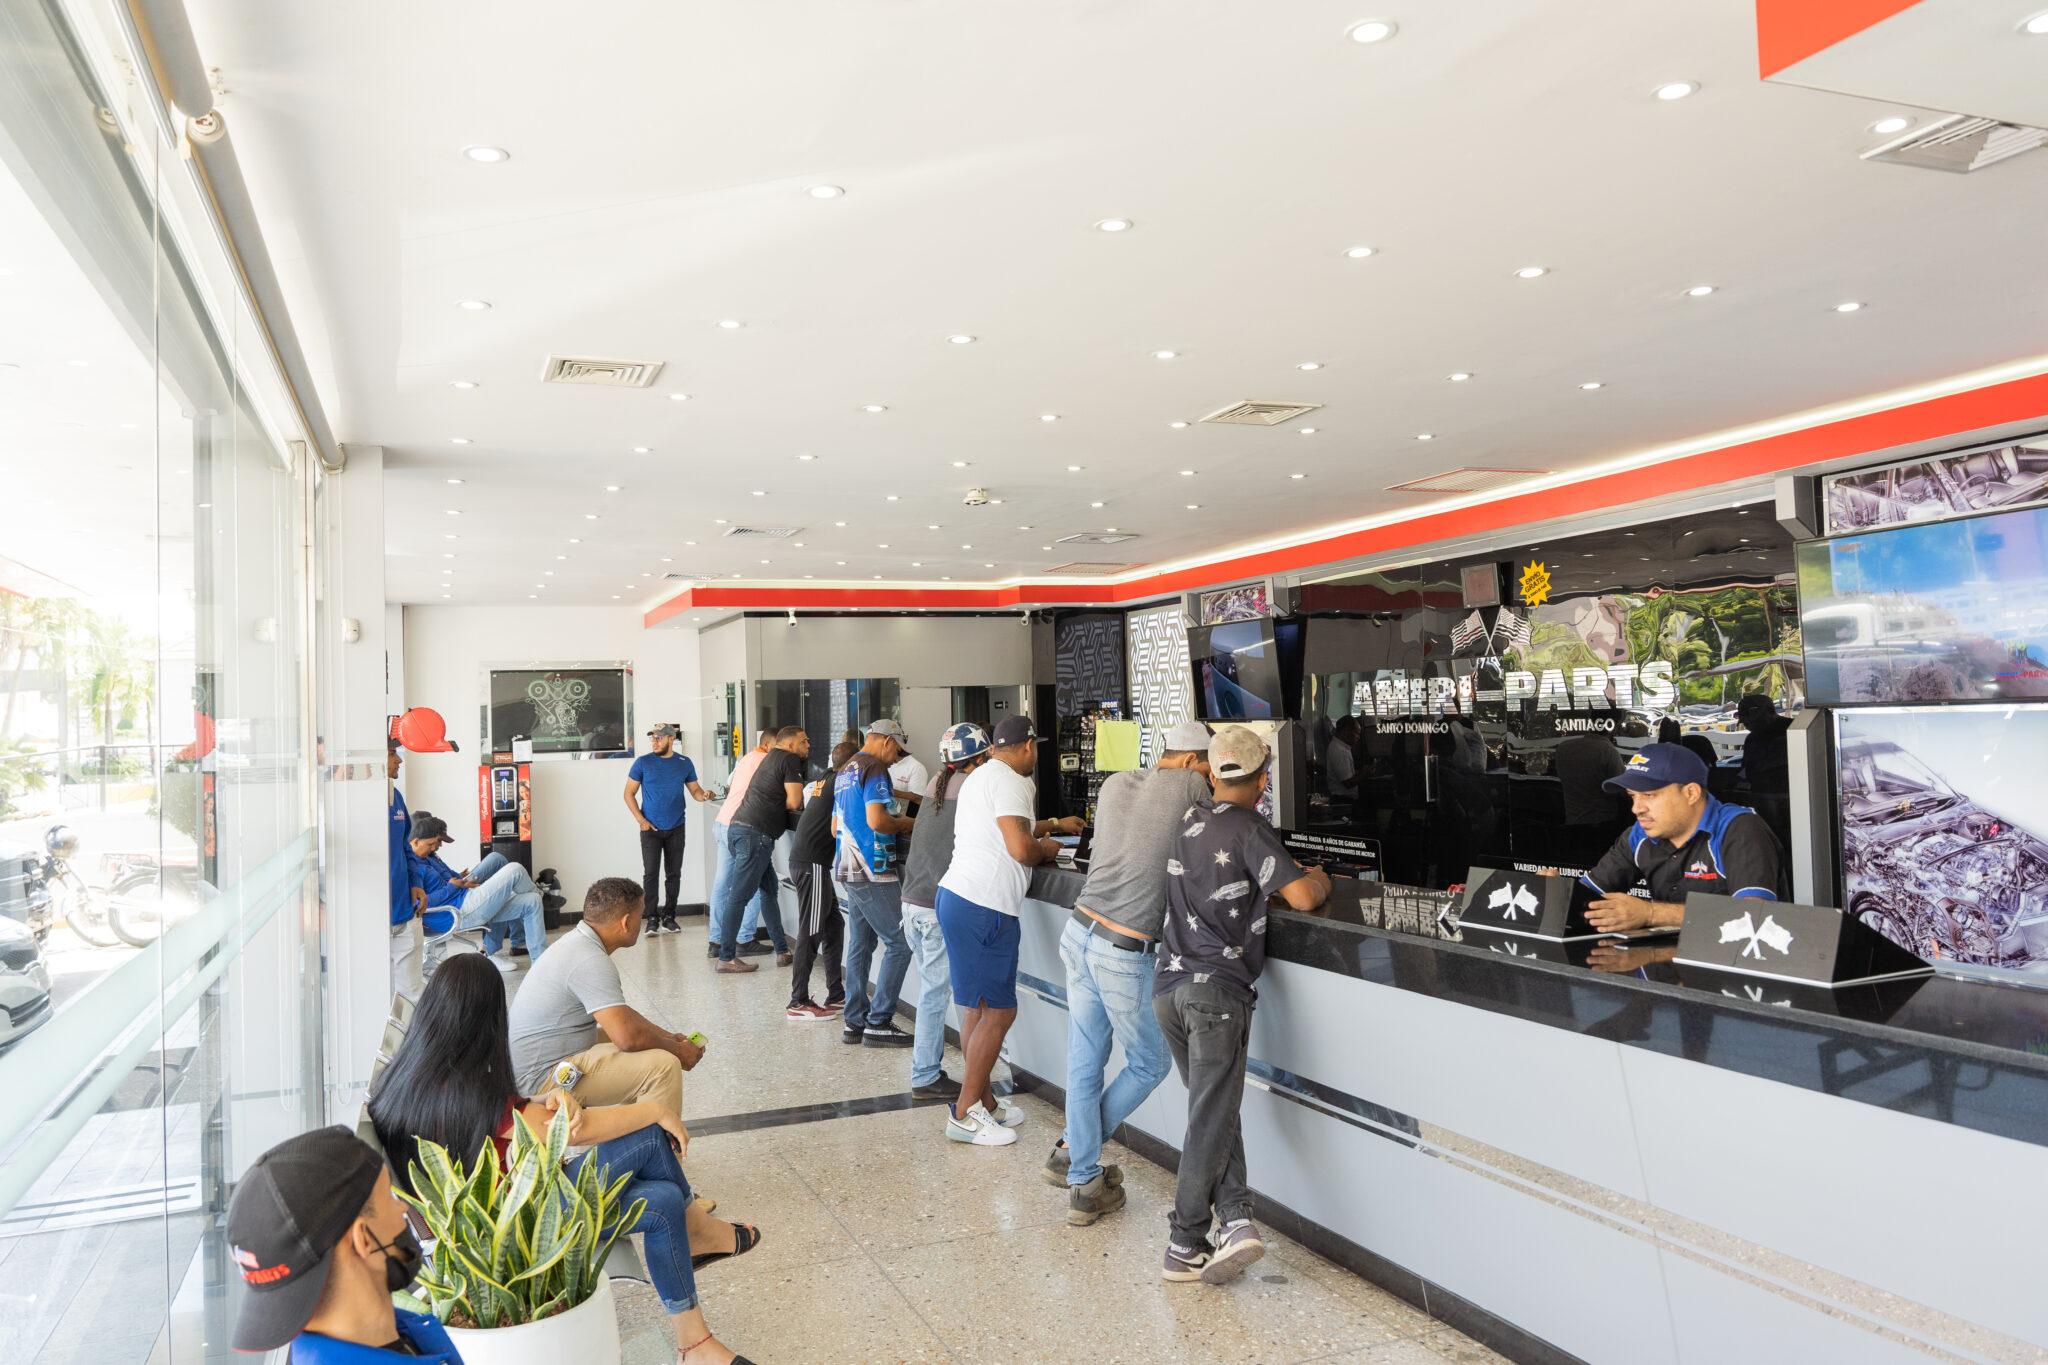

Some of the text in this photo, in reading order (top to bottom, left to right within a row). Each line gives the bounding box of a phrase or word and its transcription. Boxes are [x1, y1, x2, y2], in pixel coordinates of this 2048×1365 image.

[1376, 722, 1403, 734] SANTO
[1555, 718, 1615, 732] SANTIAGO
[1344, 840, 1367, 850] GARANTÍA
[1559, 867, 1591, 878] LUBRICA
